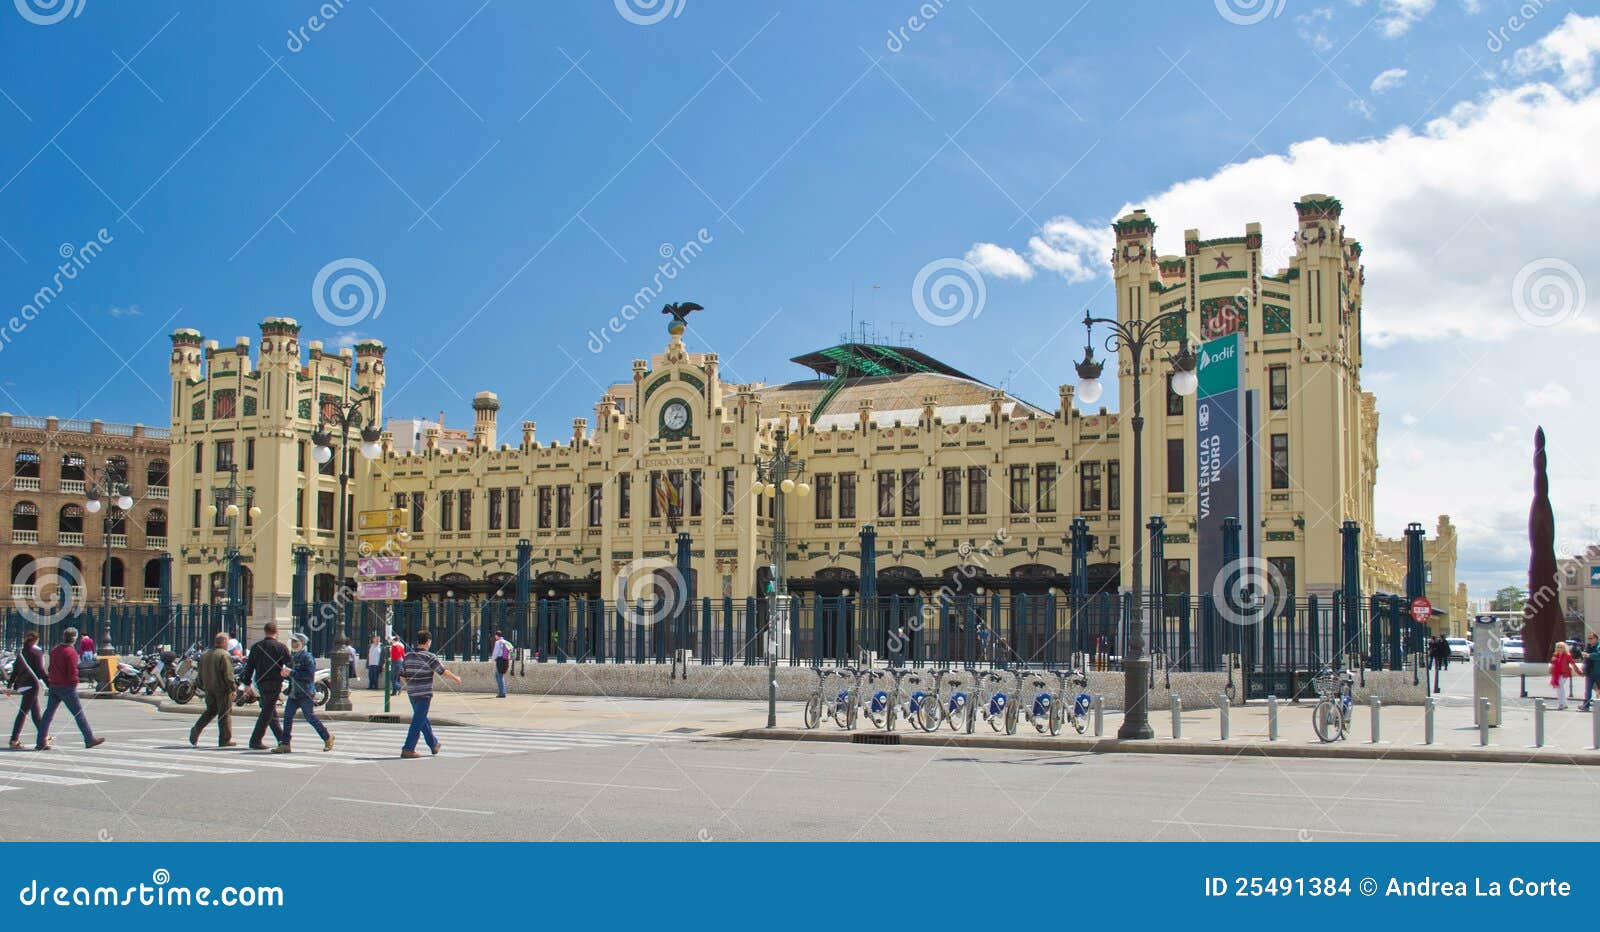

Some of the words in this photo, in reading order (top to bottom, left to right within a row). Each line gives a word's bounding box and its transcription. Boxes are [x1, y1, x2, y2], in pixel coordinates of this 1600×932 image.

[1211, 345, 1235, 363] adif
[1199, 438, 1210, 519] VALÈNCIA
[1211, 435, 1220, 482] NORD
